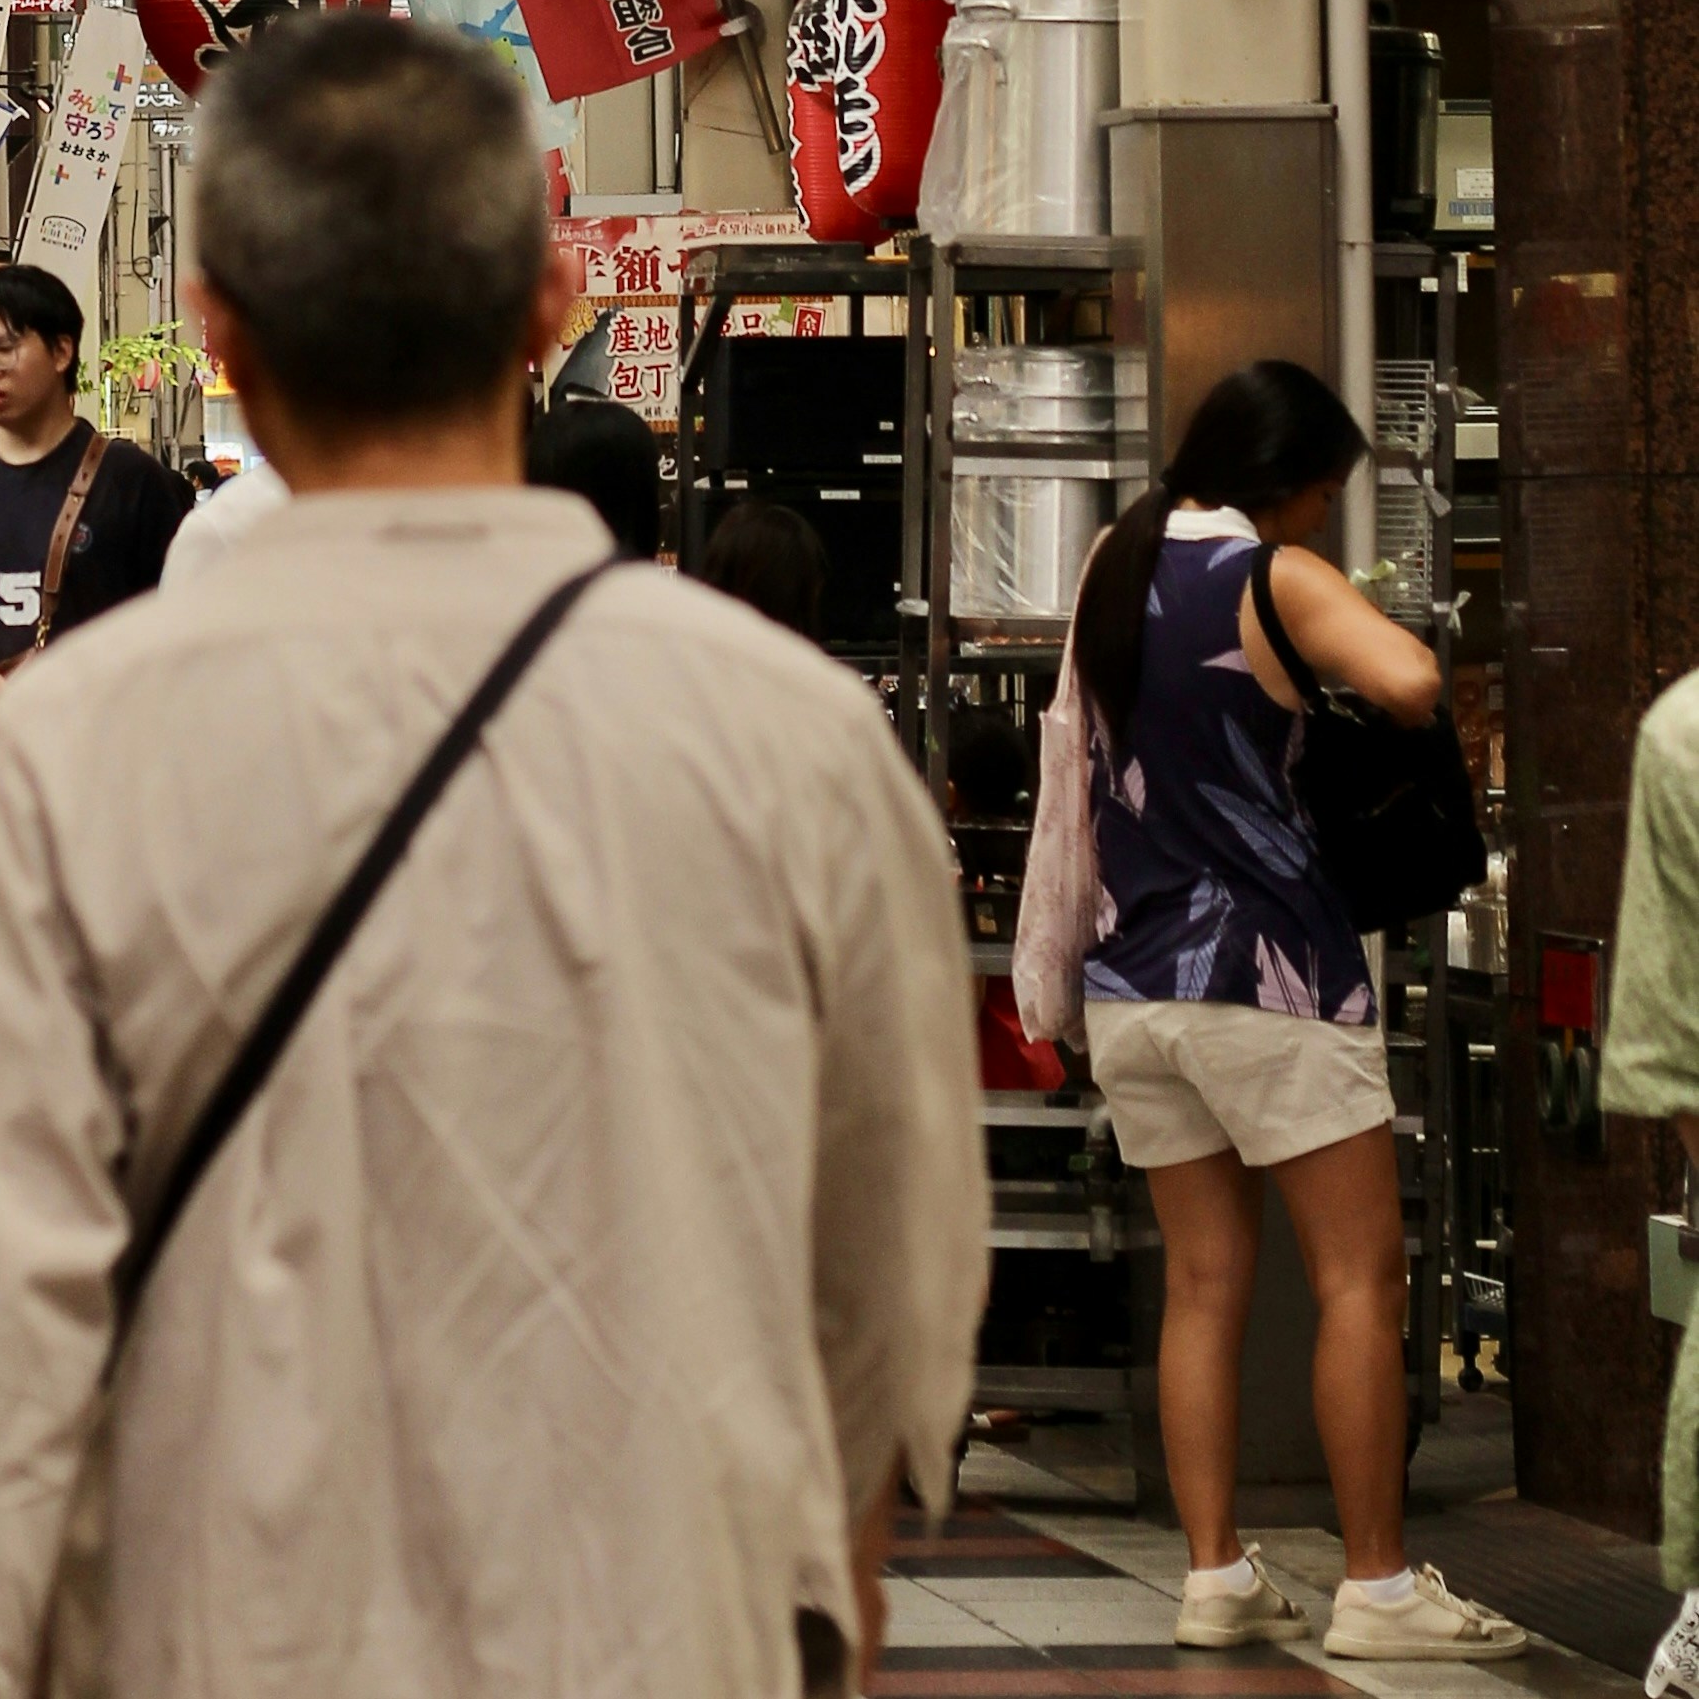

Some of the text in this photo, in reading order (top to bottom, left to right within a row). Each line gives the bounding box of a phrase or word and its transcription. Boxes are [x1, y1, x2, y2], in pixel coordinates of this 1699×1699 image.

[67, 88, 126, 121] みんなで
[64, 112, 117, 141] 守ろう
[59, 140, 111, 163] おおさか
[609, 361, 672, 402] 包丁
